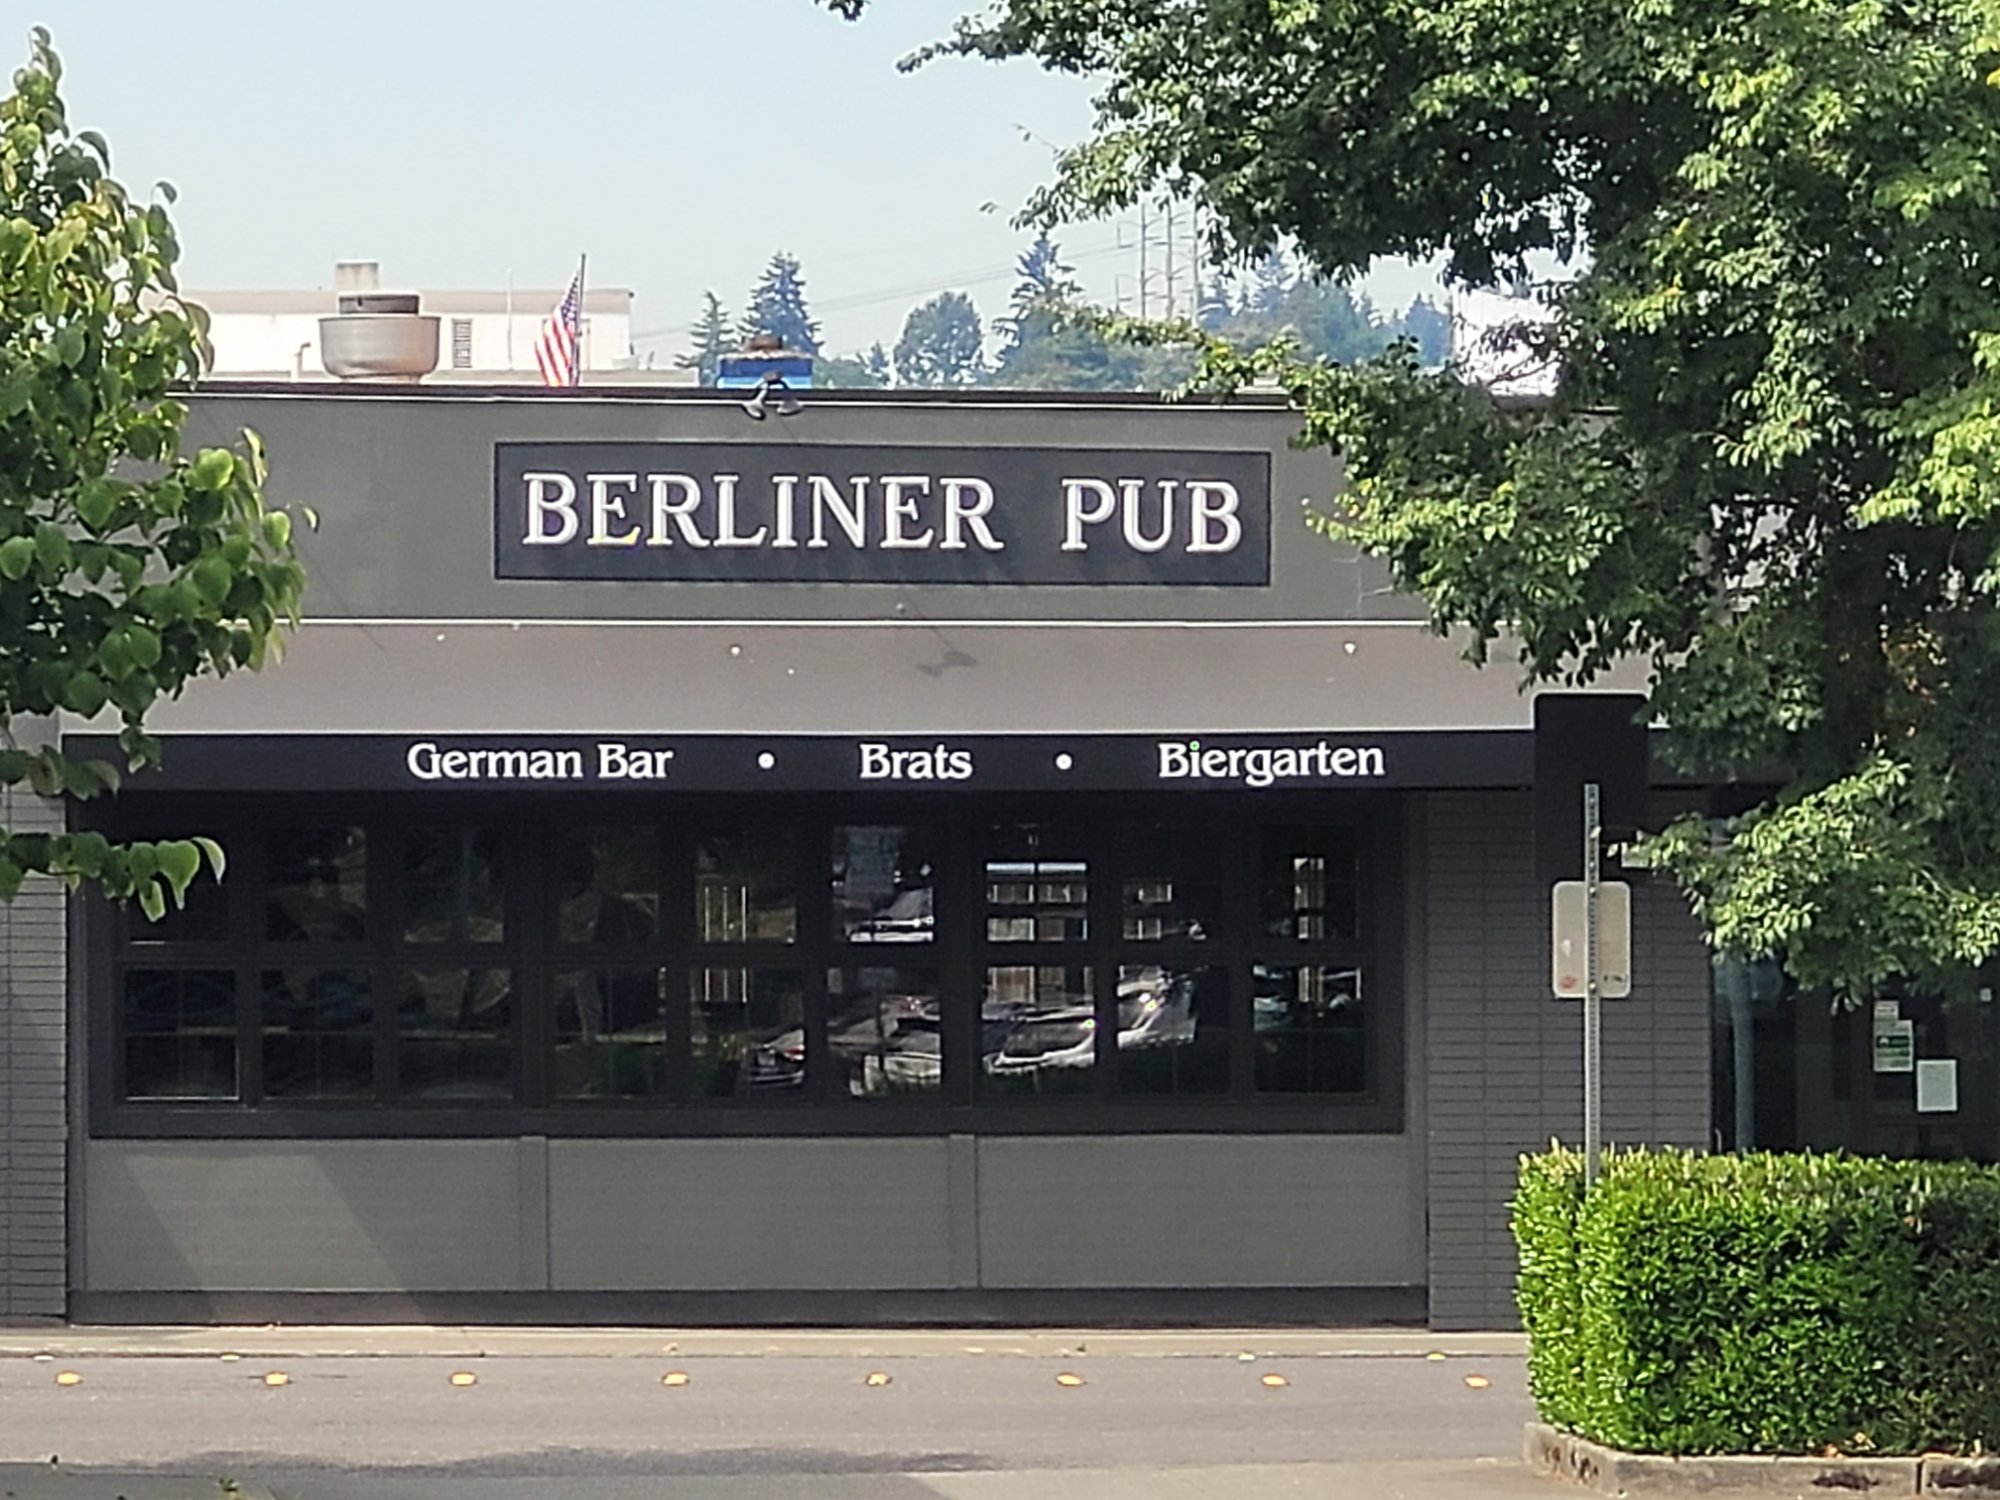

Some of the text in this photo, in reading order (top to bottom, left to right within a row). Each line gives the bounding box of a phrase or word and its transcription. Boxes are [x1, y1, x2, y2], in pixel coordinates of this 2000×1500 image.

[521, 471, 1243, 554] BERLINER PUB
[406, 740, 1385, 787] German Bar Brats Biergarten
